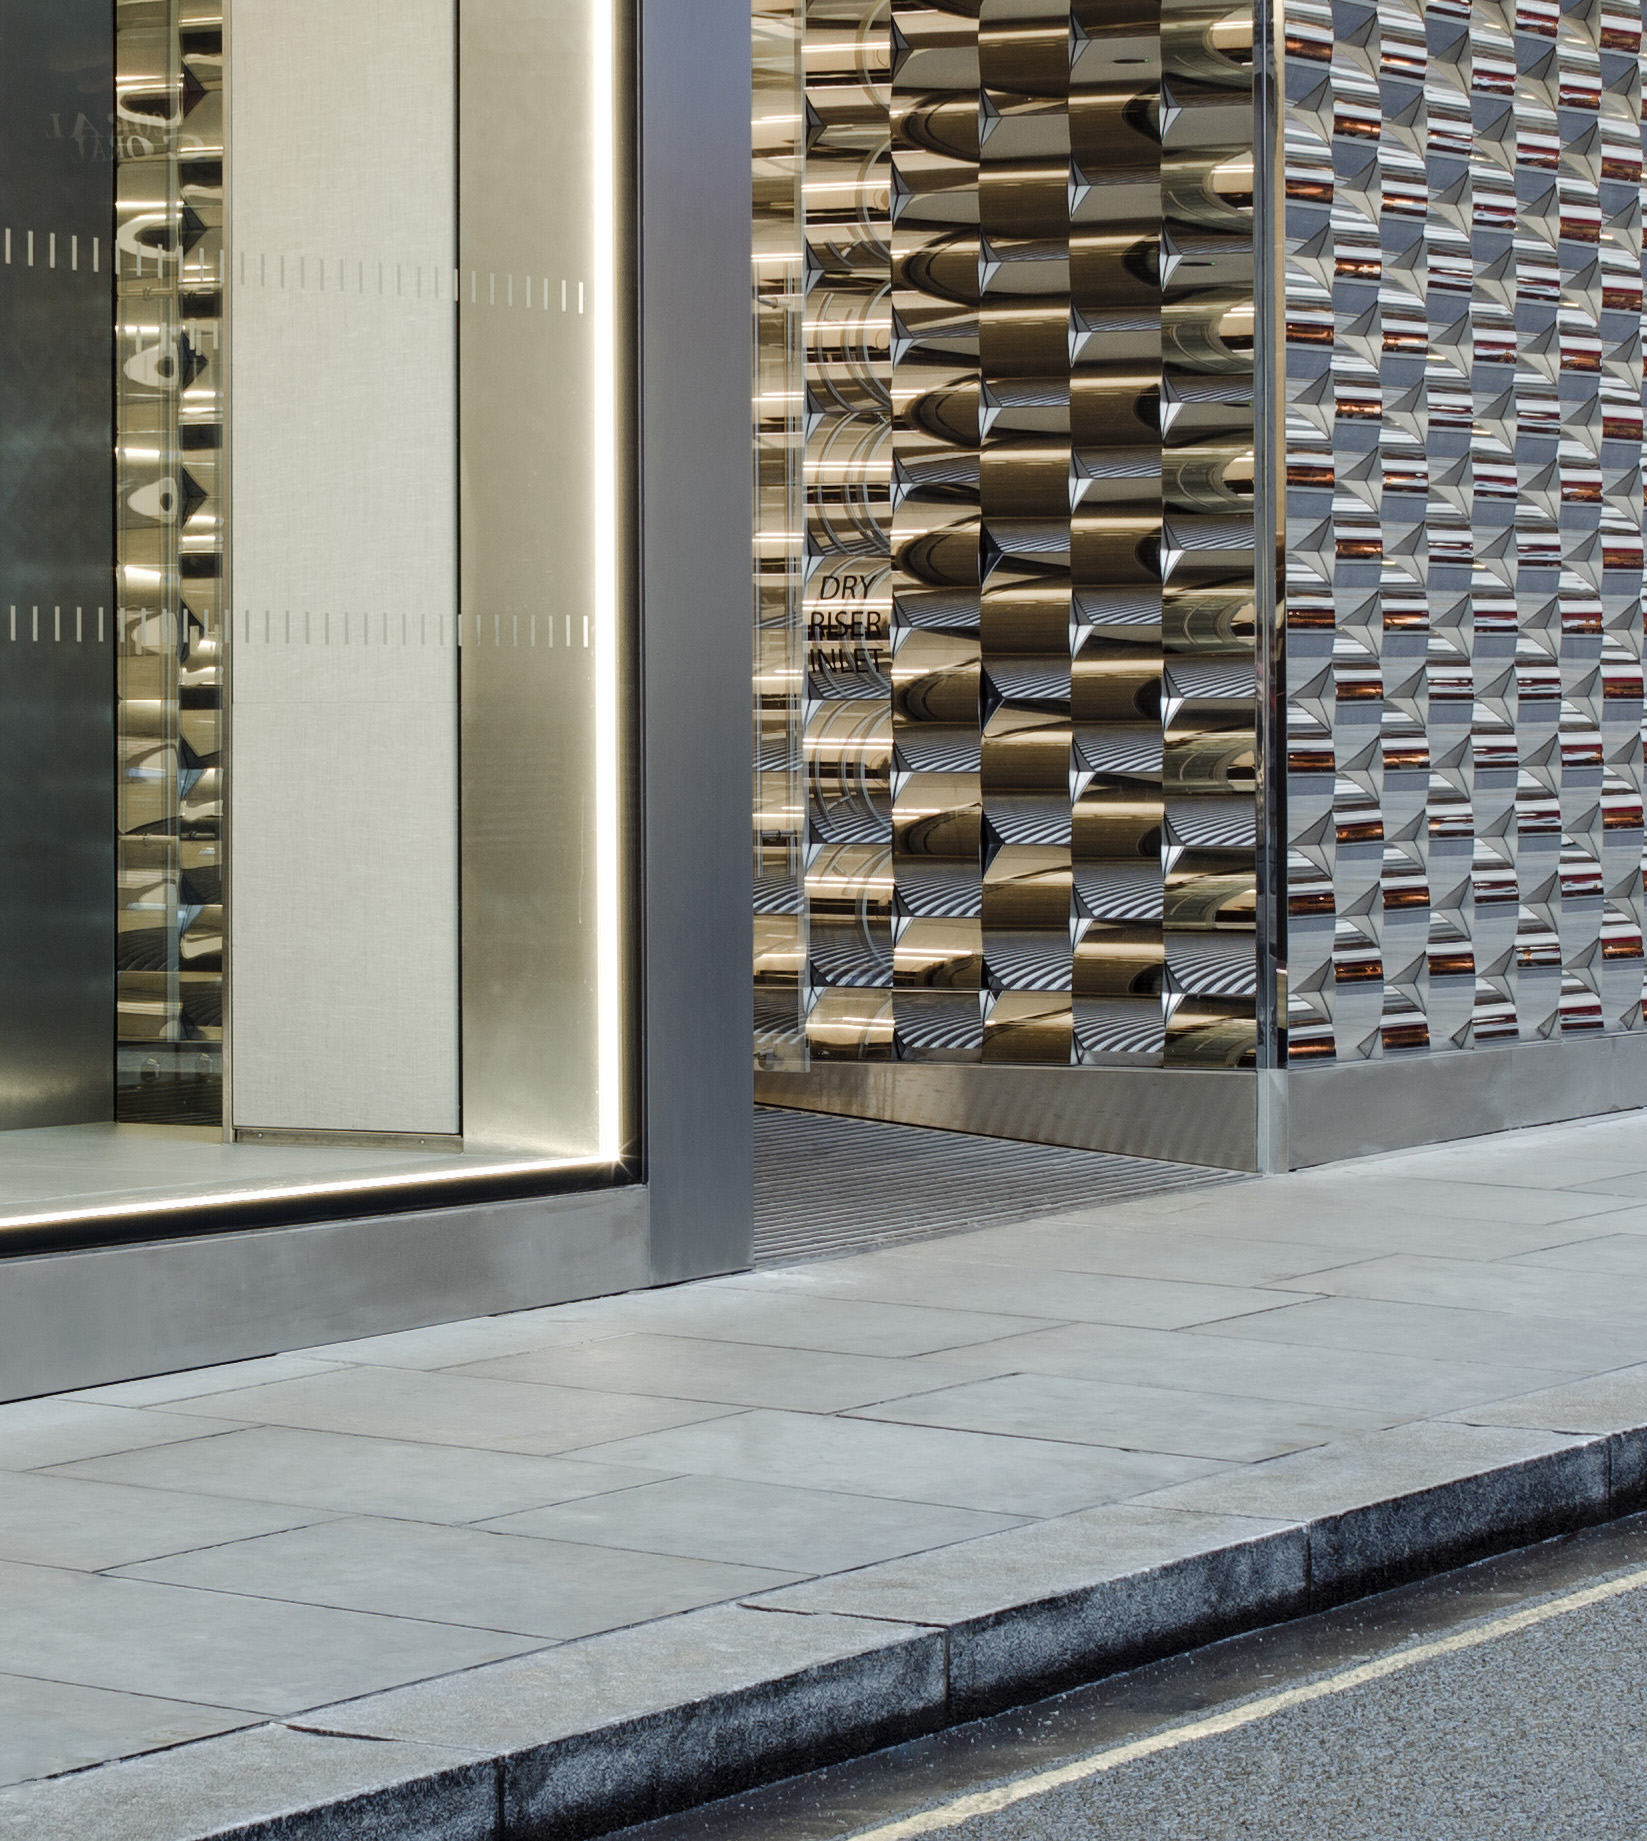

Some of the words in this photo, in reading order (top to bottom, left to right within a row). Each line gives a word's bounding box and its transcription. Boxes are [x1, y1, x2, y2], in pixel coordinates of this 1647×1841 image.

[820, 575, 878, 600] DRY
[810, 611, 881, 637] RISER
[810, 648, 883, 673] INLET
